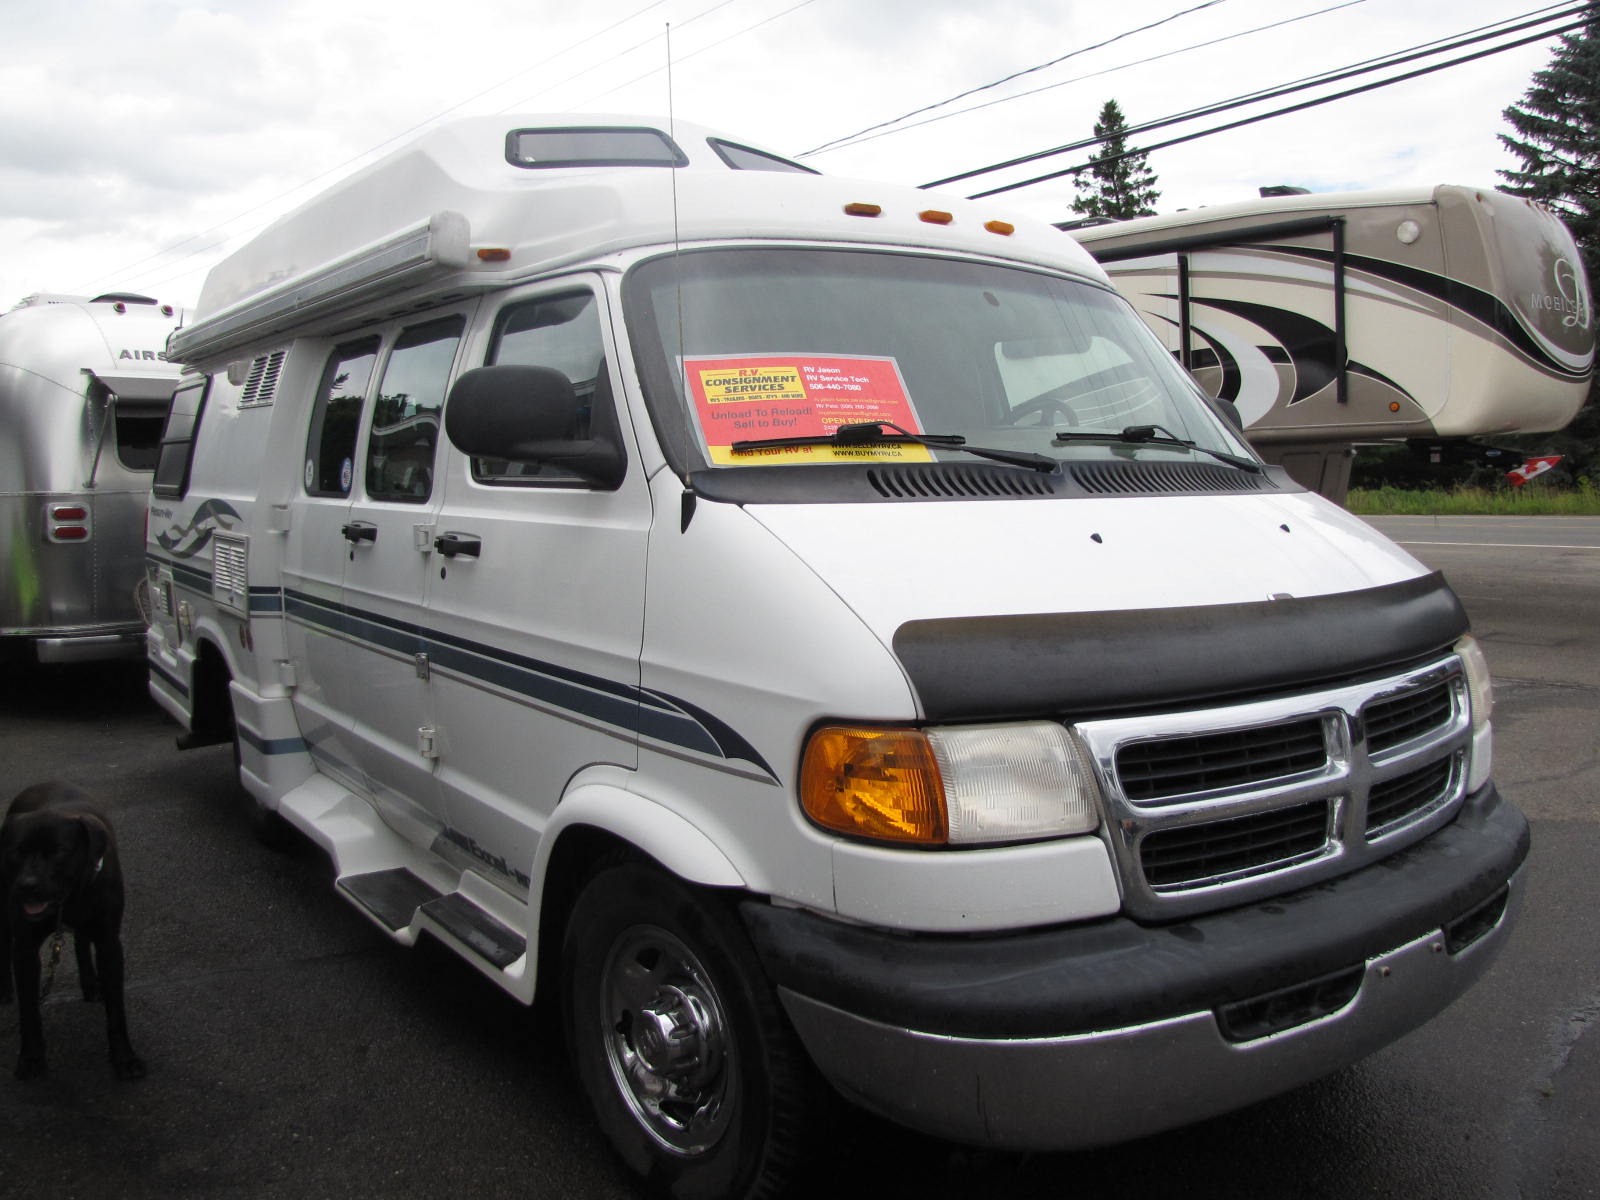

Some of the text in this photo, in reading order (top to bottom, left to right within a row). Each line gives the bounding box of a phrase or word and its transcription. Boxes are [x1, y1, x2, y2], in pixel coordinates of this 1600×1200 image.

[739, 369, 763, 377] R.V.
[705, 375, 797, 387] CONSIGNMENT
[806, 374, 818, 382] RV
[849, 376, 870, 384] Tech
[725, 383, 785, 394] SERVICES
[711, 409, 752, 420] Unload
[755, 408, 768, 417] To
[771, 407, 812, 416] Reload!
[734, 417, 797, 430] Sell to Buy!
[821, 417, 847, 425] OPEN
[757, 447, 782, 456] Your
[785, 446, 800, 454] RV
[802, 446, 814, 454] at
